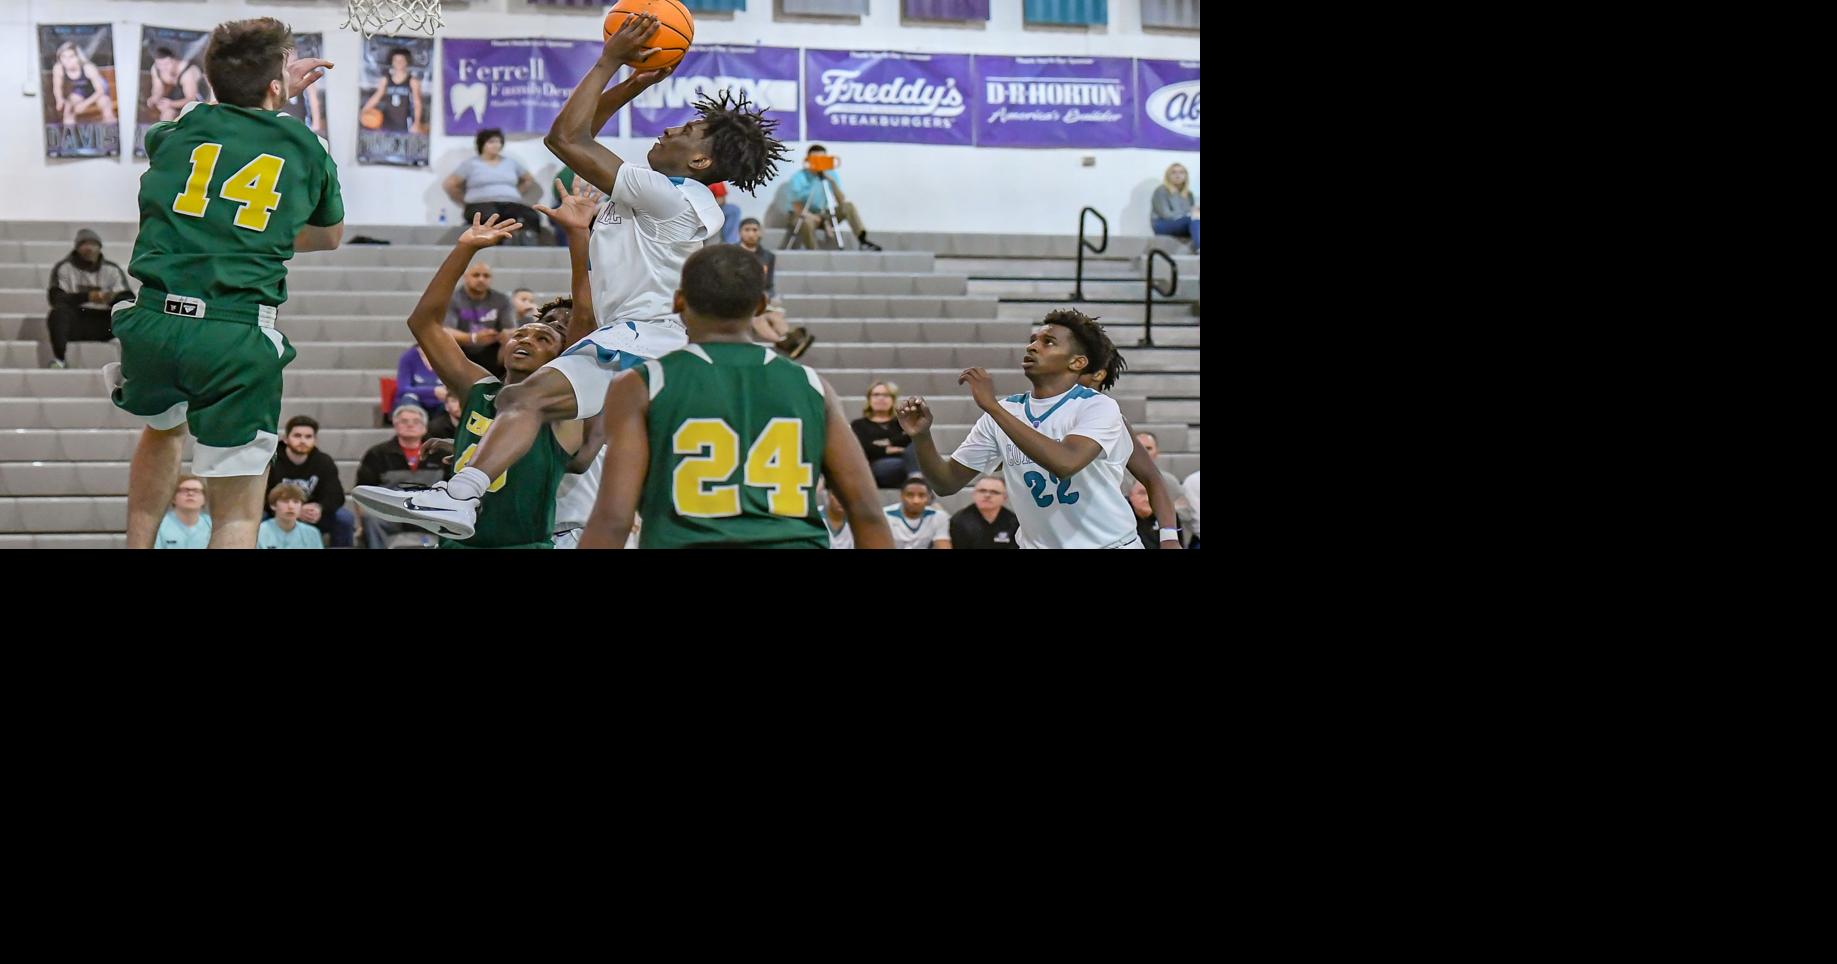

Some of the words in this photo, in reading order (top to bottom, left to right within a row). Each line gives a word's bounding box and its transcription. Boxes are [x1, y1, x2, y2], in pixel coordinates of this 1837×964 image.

[459, 58, 544, 81] Ferrell
[815, 69, 965, 112] Freddy's
[830, 114, 952, 129] STEAKBURGERS
[172, 143, 285, 232] 14
[672, 417, 813, 518] 24
[1023, 470, 1080, 508] 22
